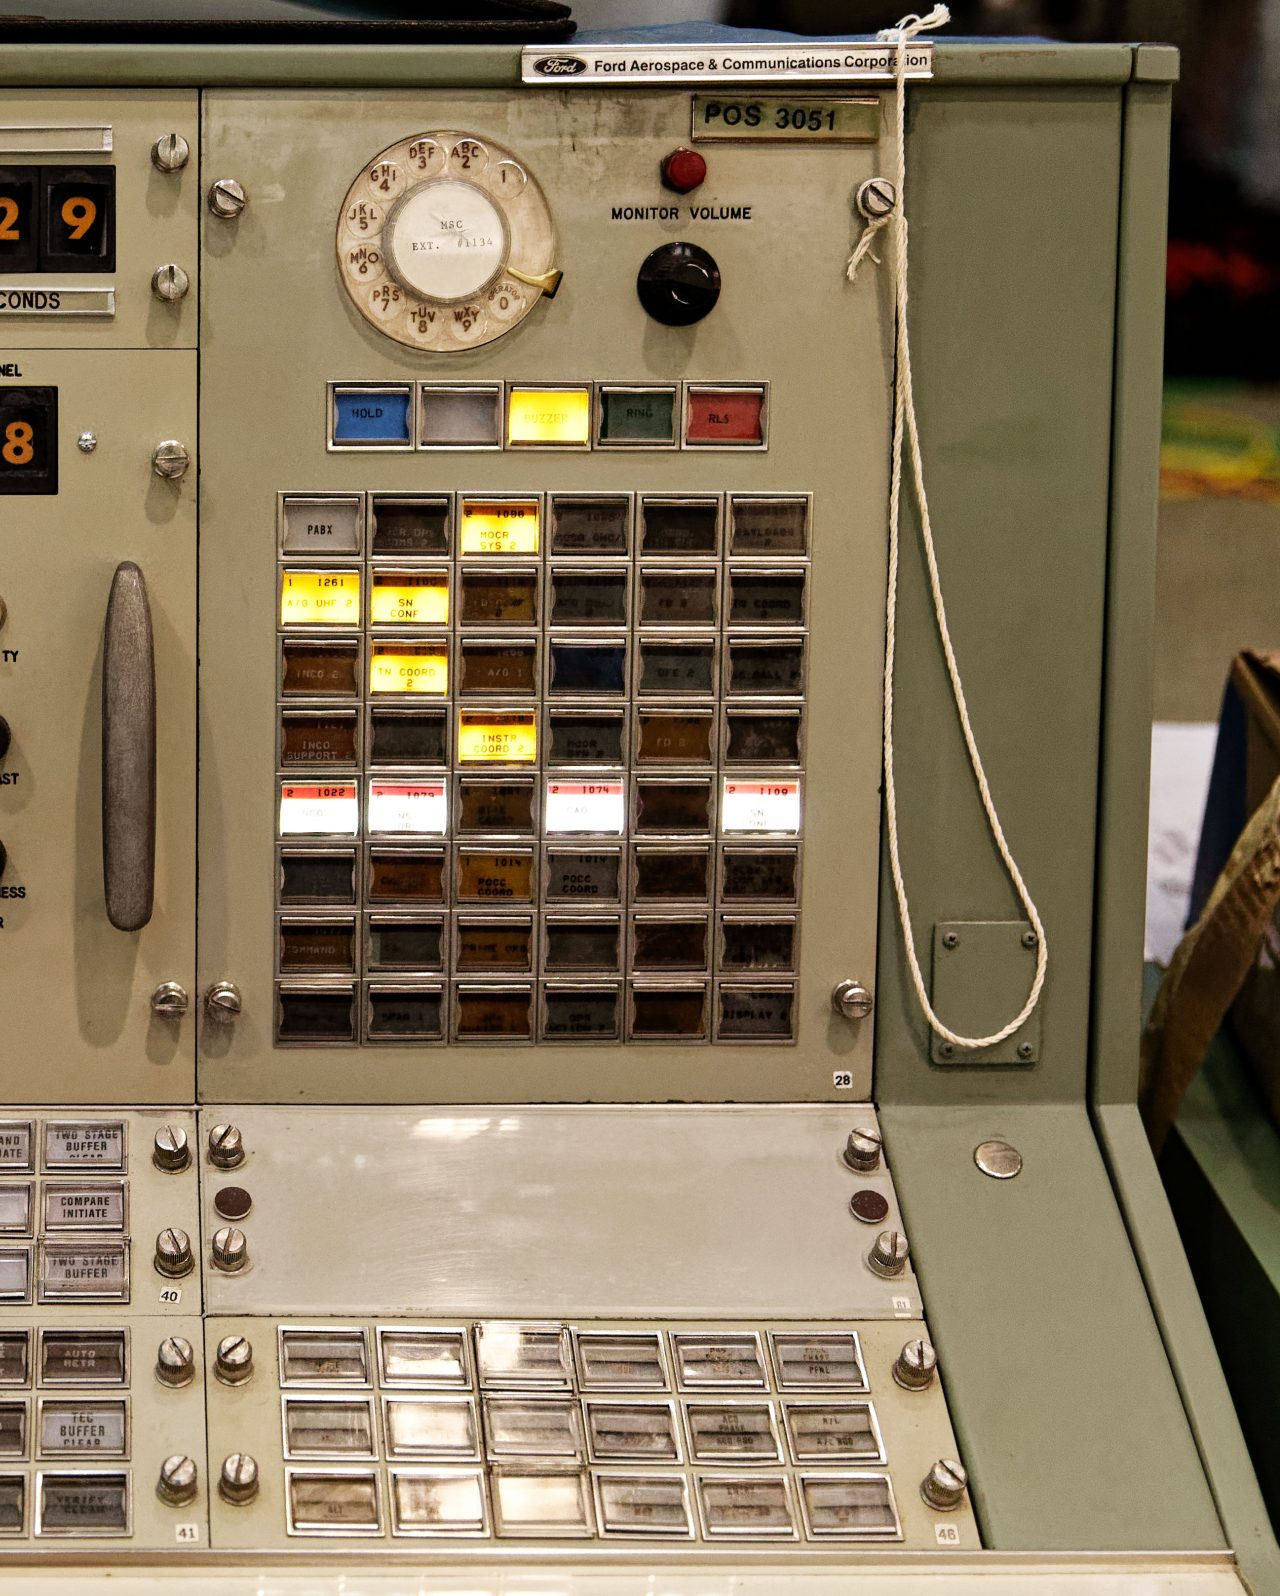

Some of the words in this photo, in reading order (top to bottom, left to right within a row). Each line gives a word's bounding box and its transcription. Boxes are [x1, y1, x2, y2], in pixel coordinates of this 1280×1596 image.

[545, 57, 577, 74] Ford
[594, 60, 626, 73] Ford
[630, 58, 705, 75] Aerospace
[708, 59, 718, 71] &
[722, 55, 841, 71] Communications
[844, 53, 928, 73] Corporaion
[705, 104, 762, 127] POS
[776, 107, 837, 132] 3051
[418, 156, 427, 169] 3
[462, 155, 471, 169] 2
[501, 169, 507, 184] 1
[379, 178, 390, 192] 4
[611, 207, 682, 221] MONITOR
[690, 206, 752, 220] VOLUME
[360, 217, 369, 230] 5
[440, 220, 463, 230] MSC
[412, 241, 440, 251] EXT.
[359, 261, 368, 274] 6
[382, 299, 390, 312] 7
[418, 319, 428, 334] 8
[463, 319, 472, 332] 9
[352, 408, 382, 419] HOLD
[627, 408, 653, 418] RING
[524, 413, 568, 424] BUZZER
[307, 525, 333, 535] PABX
[480, 531, 509, 539] MOCR
[480, 541, 502, 550] SYS
[317, 578, 344, 587] 1261
[316, 599, 336, 607] UHF
[398, 599, 413, 607] SN
[390, 610, 419, 618] CONF
[399, 668, 436, 677] COORD
[406, 679, 414, 688] 2
[482, 734, 517, 743] INSTR
[473, 745, 510, 753] COORD
[287, 751, 338, 761] SUPPORT
[287, 789, 294, 798] 2
[317, 788, 346, 797] 1022
[551, 786, 559, 794] 2
[582, 786, 609, 794] 1074
[728, 786, 736, 794] 2
[478, 878, 506, 887] POCC
[562, 874, 592, 883] POCC
[478, 889, 514, 897] COORD
[562, 884, 598, 893] COORD
[835, 1075, 850, 1085] 28
[55, 1130, 78, 1140] TWO
[66, 1141, 107, 1151] BUFFER
[61, 1197, 110, 1206] COMPARE
[63, 1209, 108, 1218] INITIATE
[64, 1268, 108, 1279] BUFFER
[161, 1290, 178, 1302] 40
[65, 1350, 96, 1358] AUTO
[60, 1426, 105, 1437] BUFFER
[179, 1528, 195, 1539] 41
[938, 1528, 956, 1540] 46
